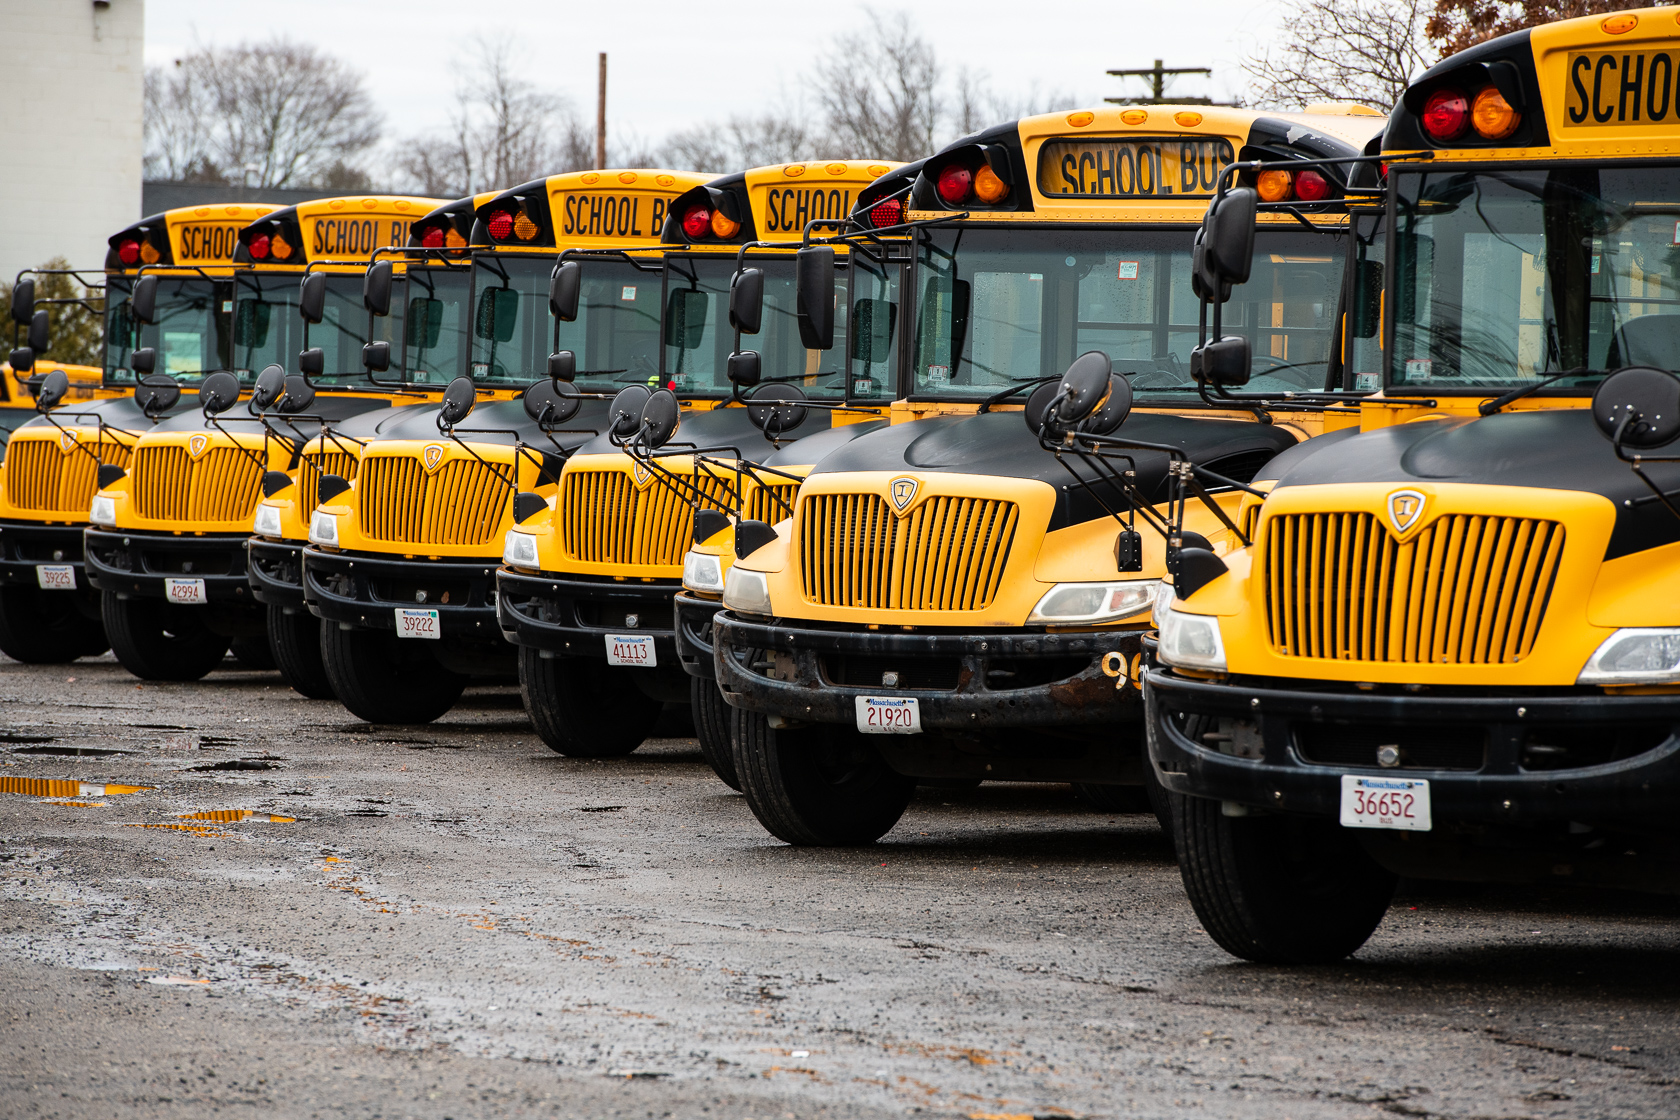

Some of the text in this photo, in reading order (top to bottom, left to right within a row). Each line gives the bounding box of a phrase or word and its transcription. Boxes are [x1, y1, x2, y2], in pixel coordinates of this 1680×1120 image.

[1569, 53, 1680, 124] SCHO
[1061, 145, 1173, 195] SCHOOL
[564, 195, 642, 236] SCHOOL
[767, 189, 850, 231] SCHOOL
[181, 226, 241, 259] SCHOO
[315, 219, 379, 254] SCHOOL
[44, 572, 71, 585] 39225
[171, 585, 199, 599] 42994
[402, 616, 434, 632] 39222
[613, 643, 648, 660] 41113
[867, 706, 912, 727] 21920
[1353, 789, 1416, 819] 36652
